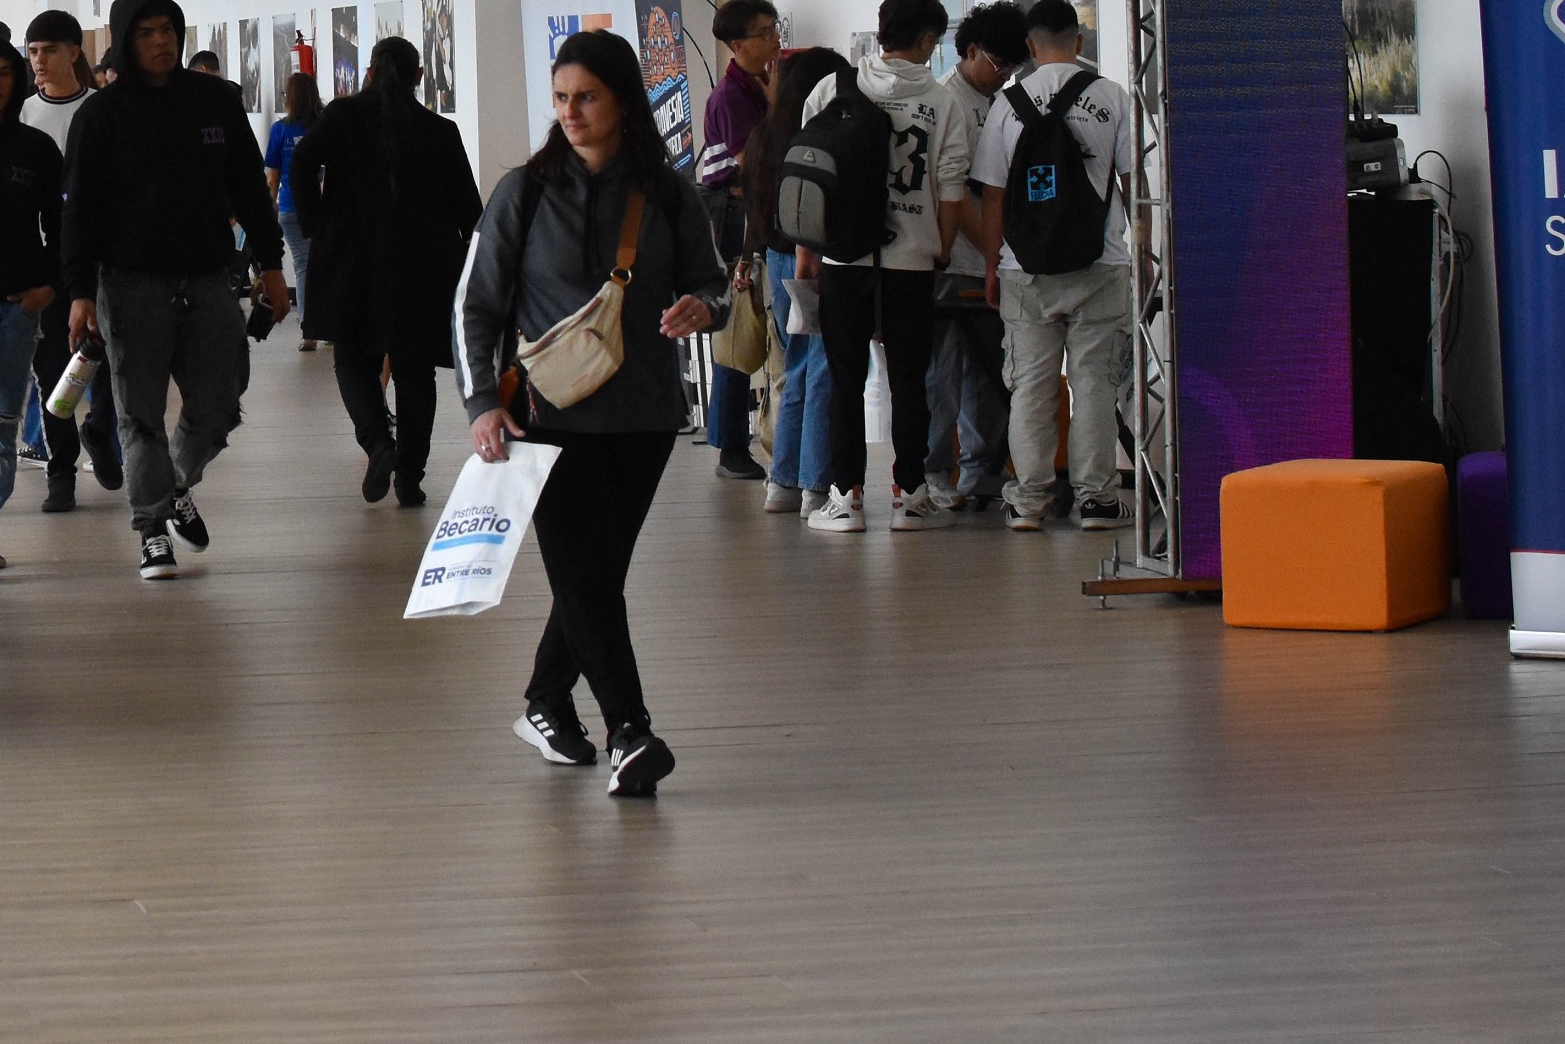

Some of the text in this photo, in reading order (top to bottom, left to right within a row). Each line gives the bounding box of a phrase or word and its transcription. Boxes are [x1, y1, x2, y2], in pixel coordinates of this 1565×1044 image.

[435, 513, 511, 540] Becario
[421, 566, 446, 587] ER
[446, 568, 470, 579] ENTRE
